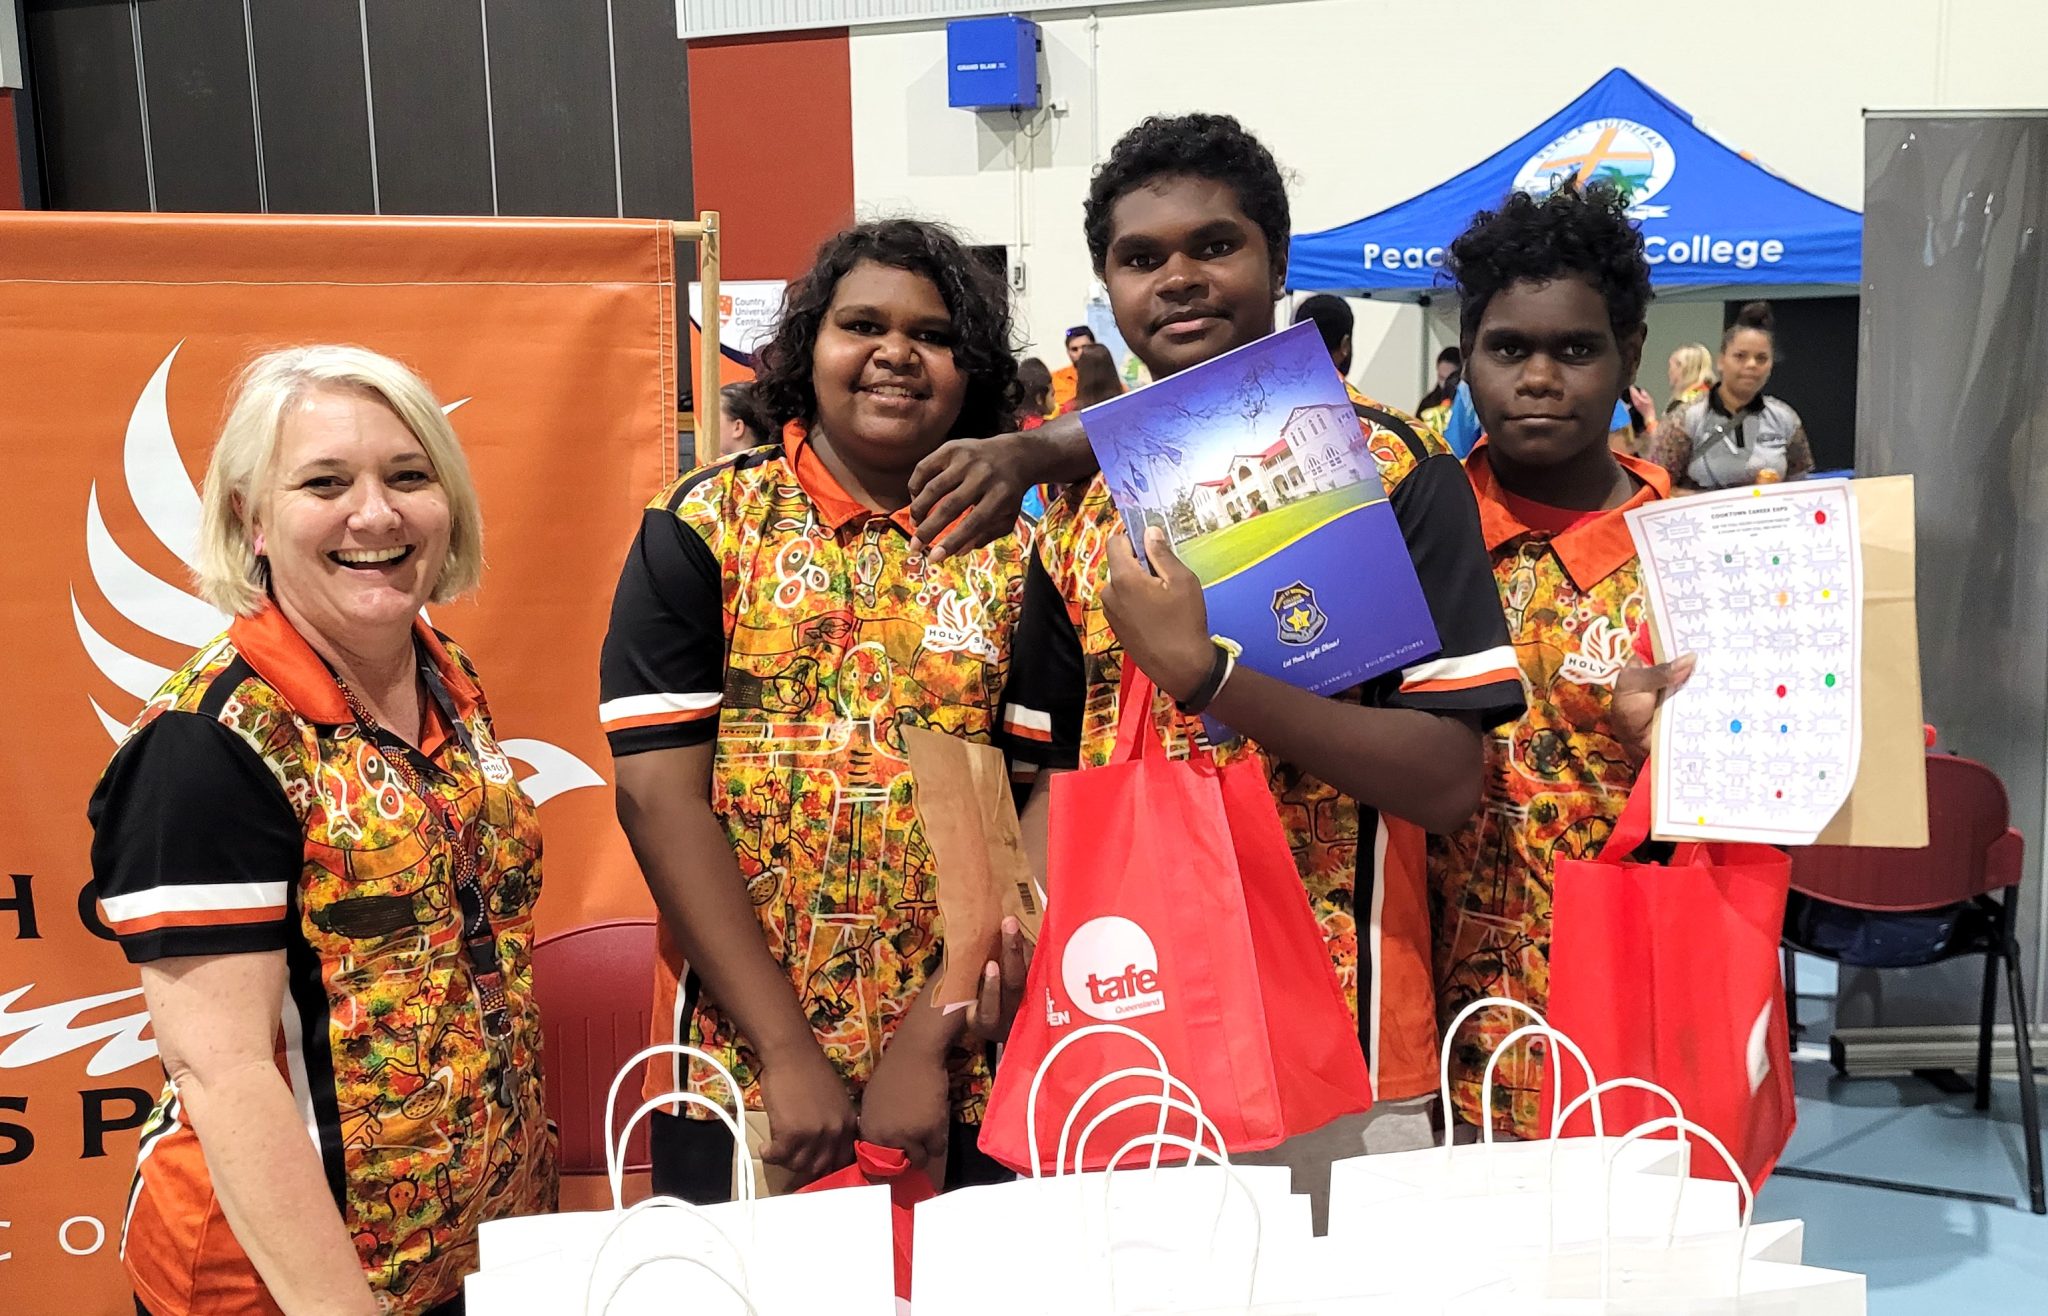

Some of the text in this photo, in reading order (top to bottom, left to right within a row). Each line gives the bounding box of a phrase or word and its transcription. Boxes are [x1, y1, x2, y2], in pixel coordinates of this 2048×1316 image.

[1363, 234, 1785, 270] Peac College
[735, 297, 766, 307] Country
[929, 629, 962, 641] HOLY
[1568, 657, 1607, 674] HOLY
[1086, 964, 1158, 1004] tafe
[1115, 998, 1160, 1014] Queensland
